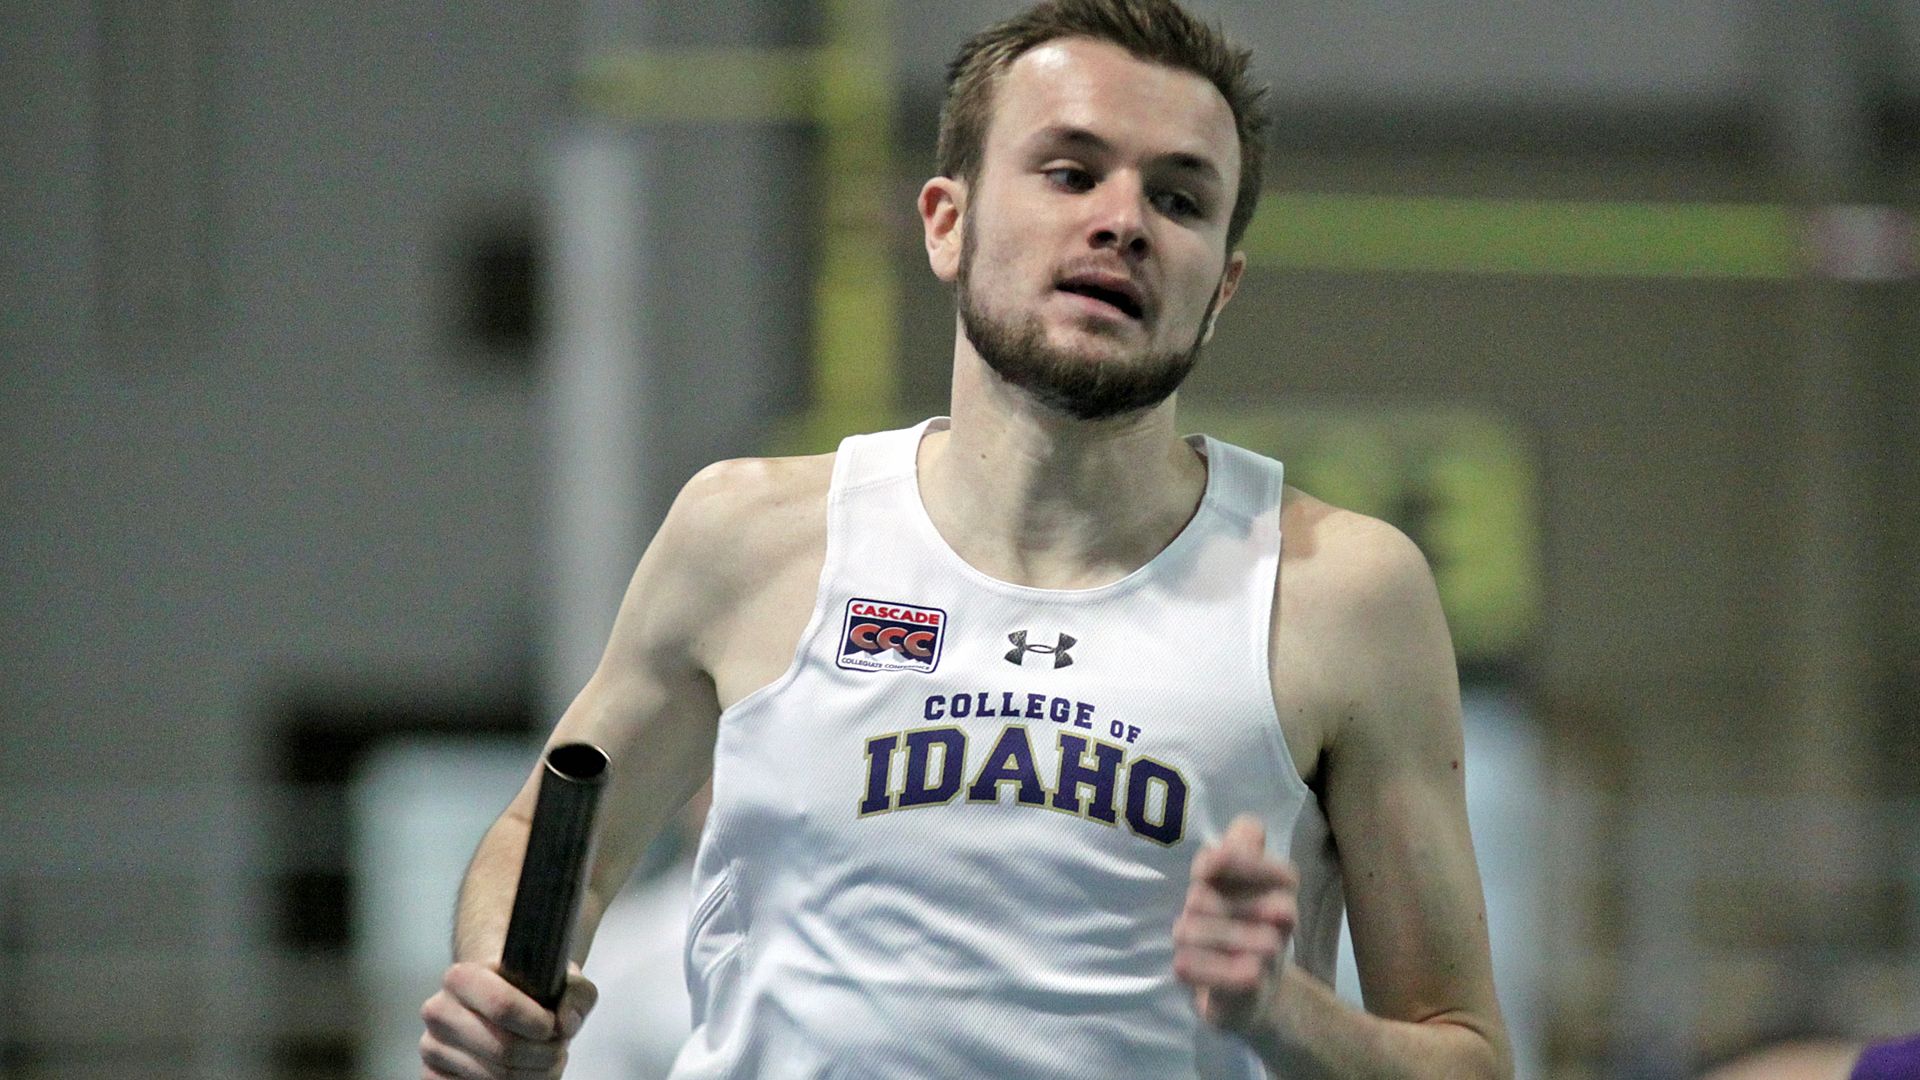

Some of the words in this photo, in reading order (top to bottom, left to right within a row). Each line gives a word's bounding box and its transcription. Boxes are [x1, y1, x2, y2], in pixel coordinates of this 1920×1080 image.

[852, 604, 939, 625] CASCADE
[850, 623, 935, 656] CCC
[841, 657, 883, 668] COLLEGIATE
[884, 662, 930, 670] CONFCE
[924, 692, 1095, 729] COLLEGE
[1110, 720, 1142, 743] OF
[857, 724, 1190, 848] IDAHO
